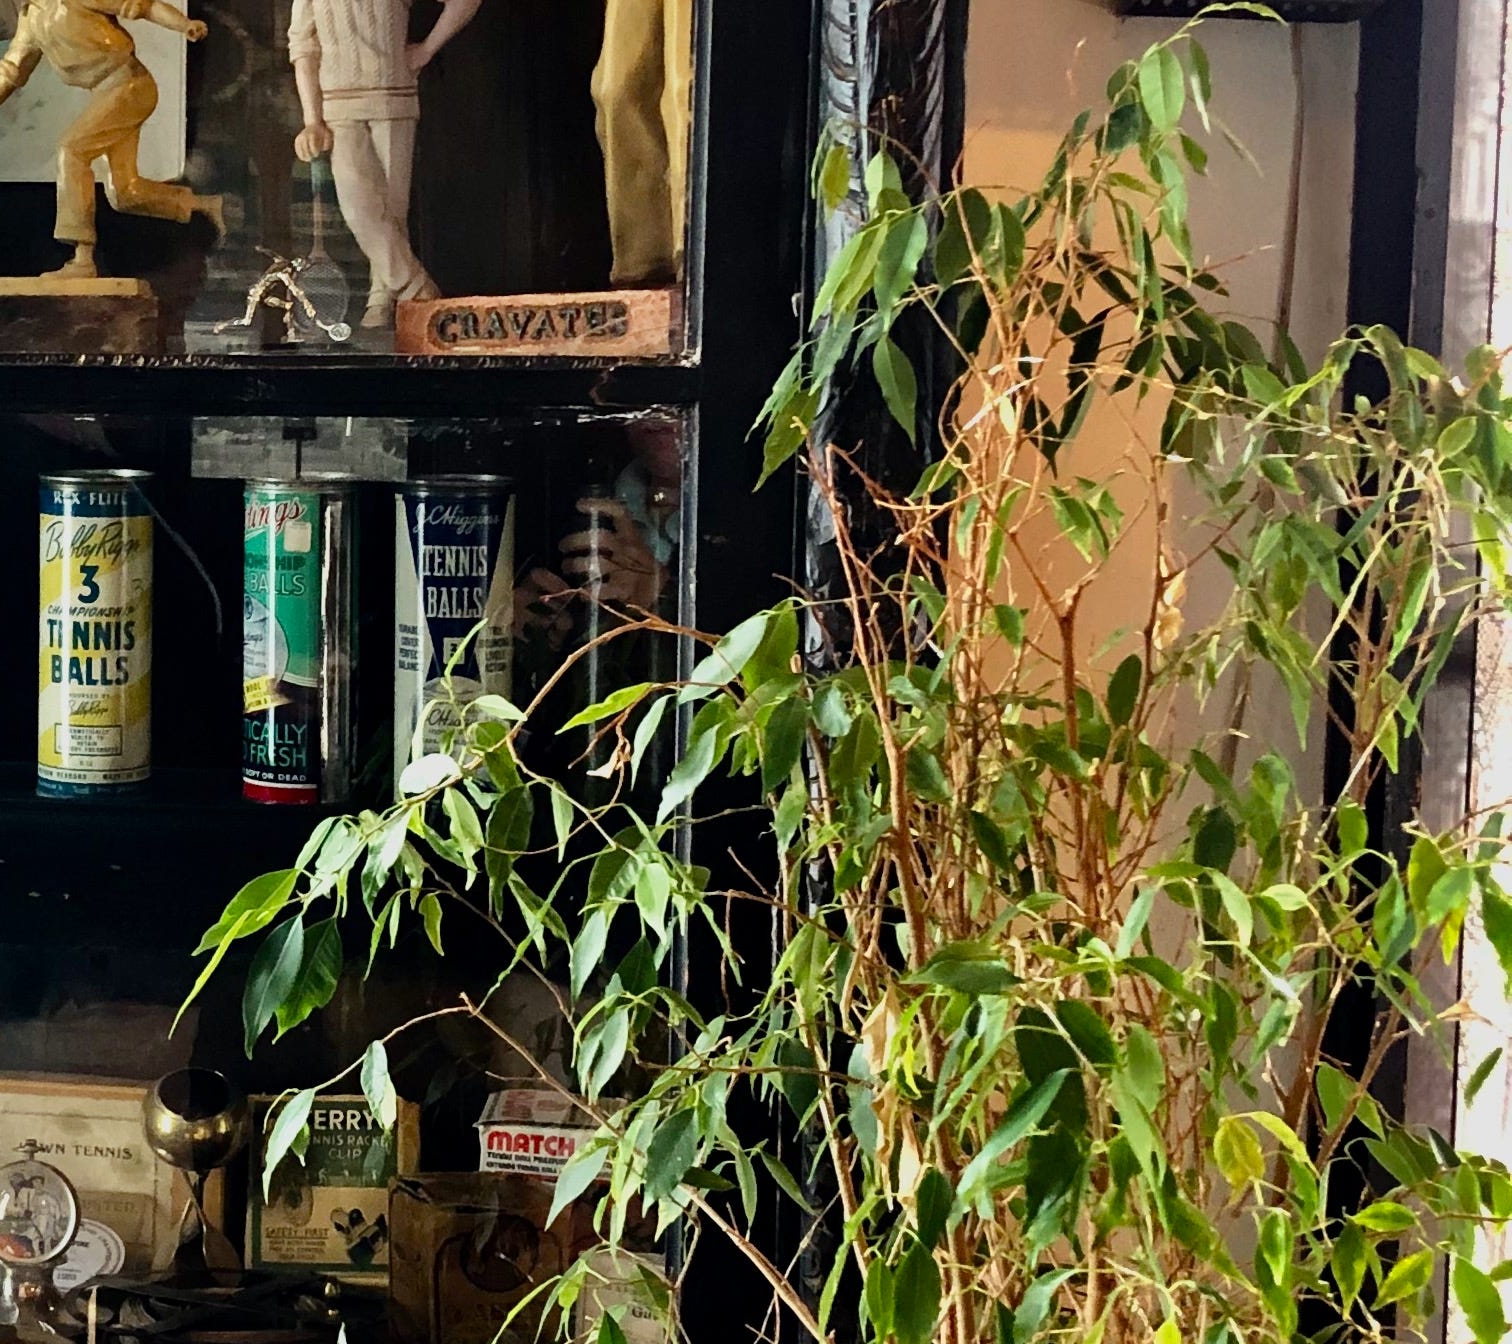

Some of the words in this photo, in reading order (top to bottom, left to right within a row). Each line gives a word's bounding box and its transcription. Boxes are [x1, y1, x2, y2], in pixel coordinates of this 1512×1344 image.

[52, 490, 129, 506] RX-FLITE
[423, 544, 488, 577] TENNIS
[77, 564, 101, 604] 3
[426, 586, 484, 619] BALLS
[51, 654, 129, 686] BALLS
[278, 773, 307, 782] DEAD
[309, 1109, 375, 1131] ERRY
[72, 1143, 133, 1160] TENNIS
[311, 1134, 344, 1146] NNIS
[487, 1130, 576, 1157] MATCH
